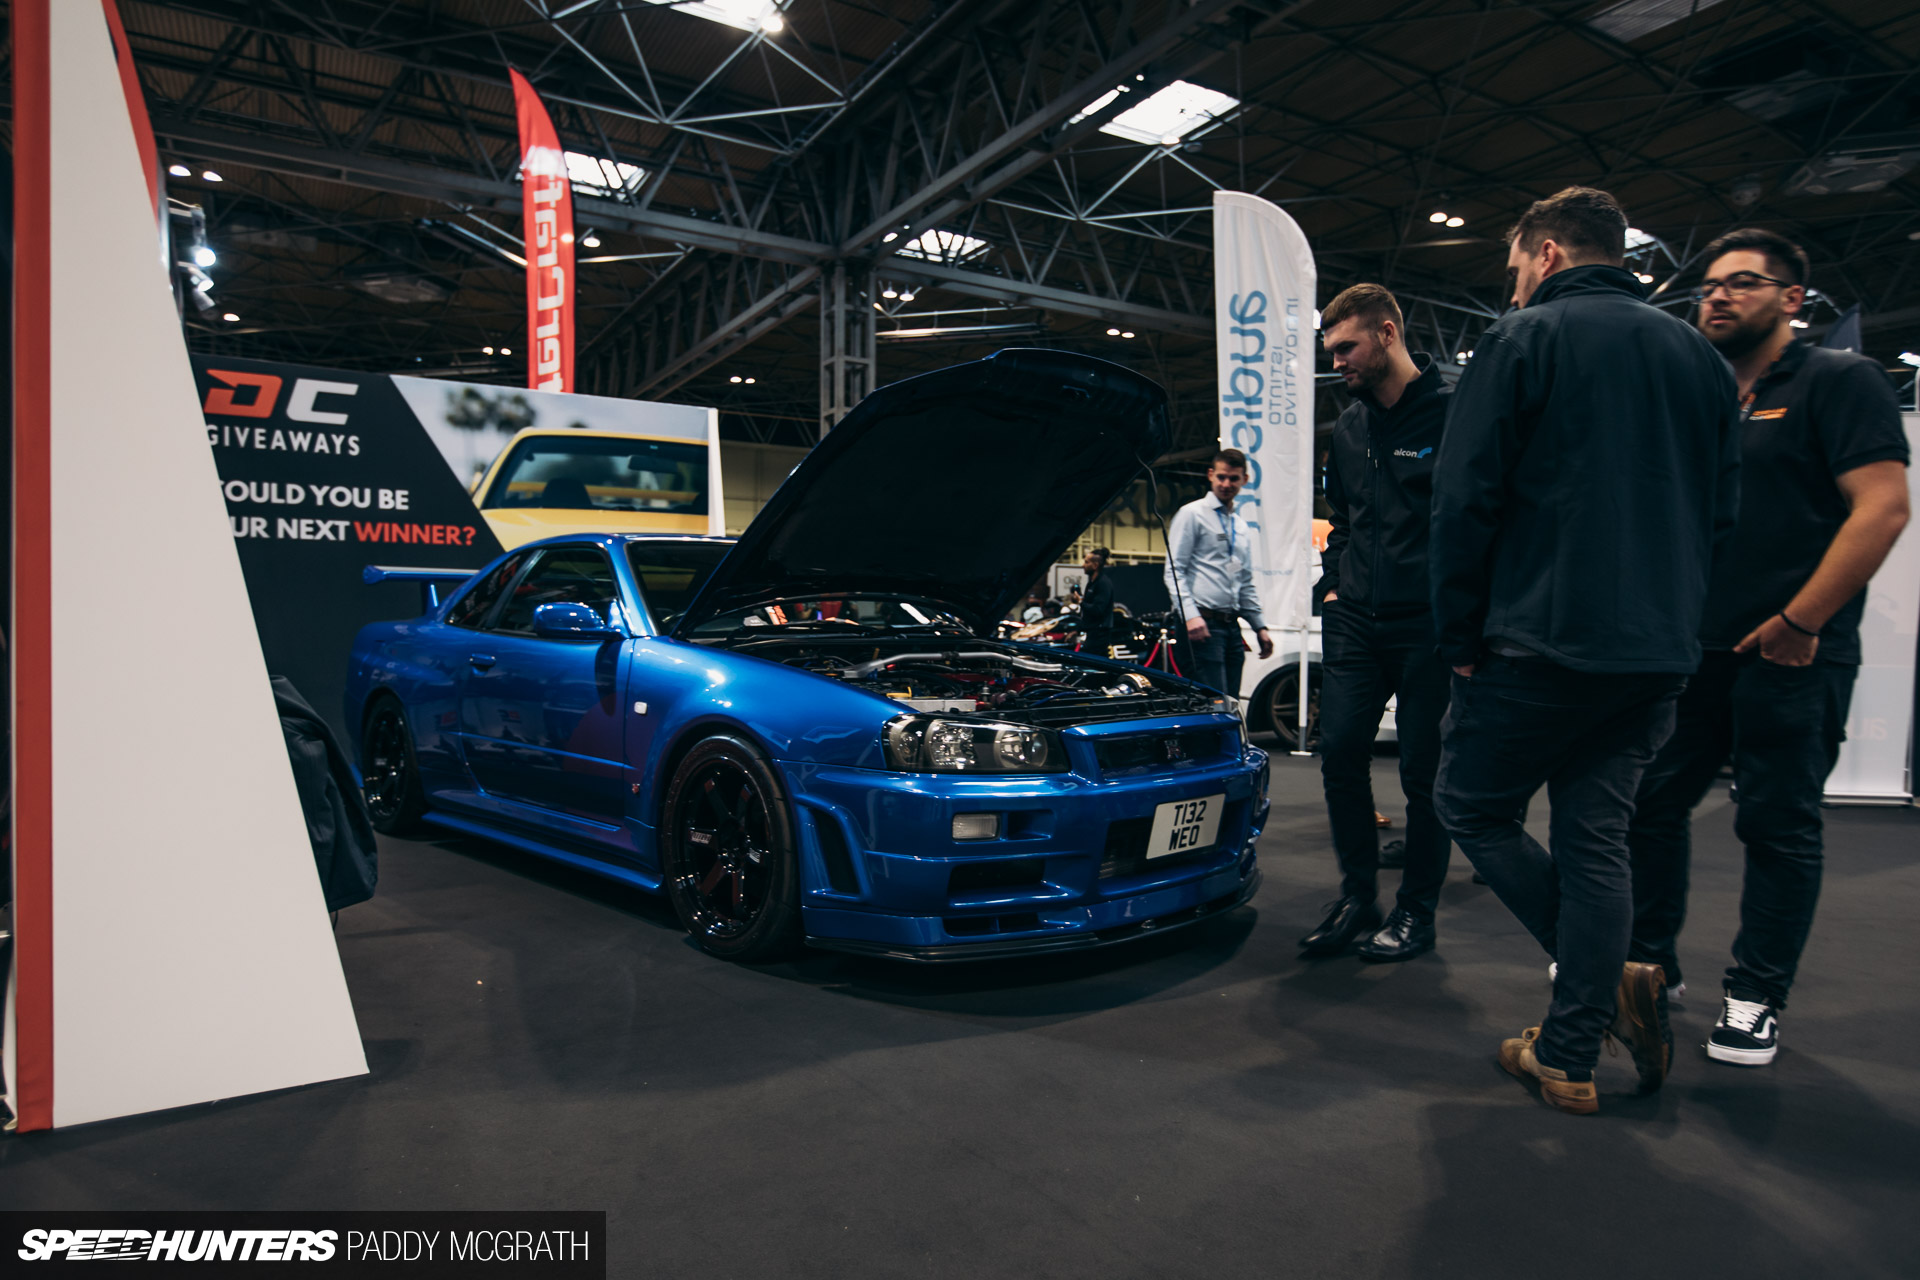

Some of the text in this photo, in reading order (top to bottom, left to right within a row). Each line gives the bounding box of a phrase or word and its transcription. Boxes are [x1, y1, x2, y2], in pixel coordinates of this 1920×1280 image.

[203, 368, 359, 425] DC
[206, 424, 360, 456] GIVEAWAYS
[1393, 448, 1418, 458] alcon
[220, 480, 409, 510] OULD YOU BE
[230, 516, 476, 546] UR NEXT WINNER?
[1173, 800, 1207, 826] T132
